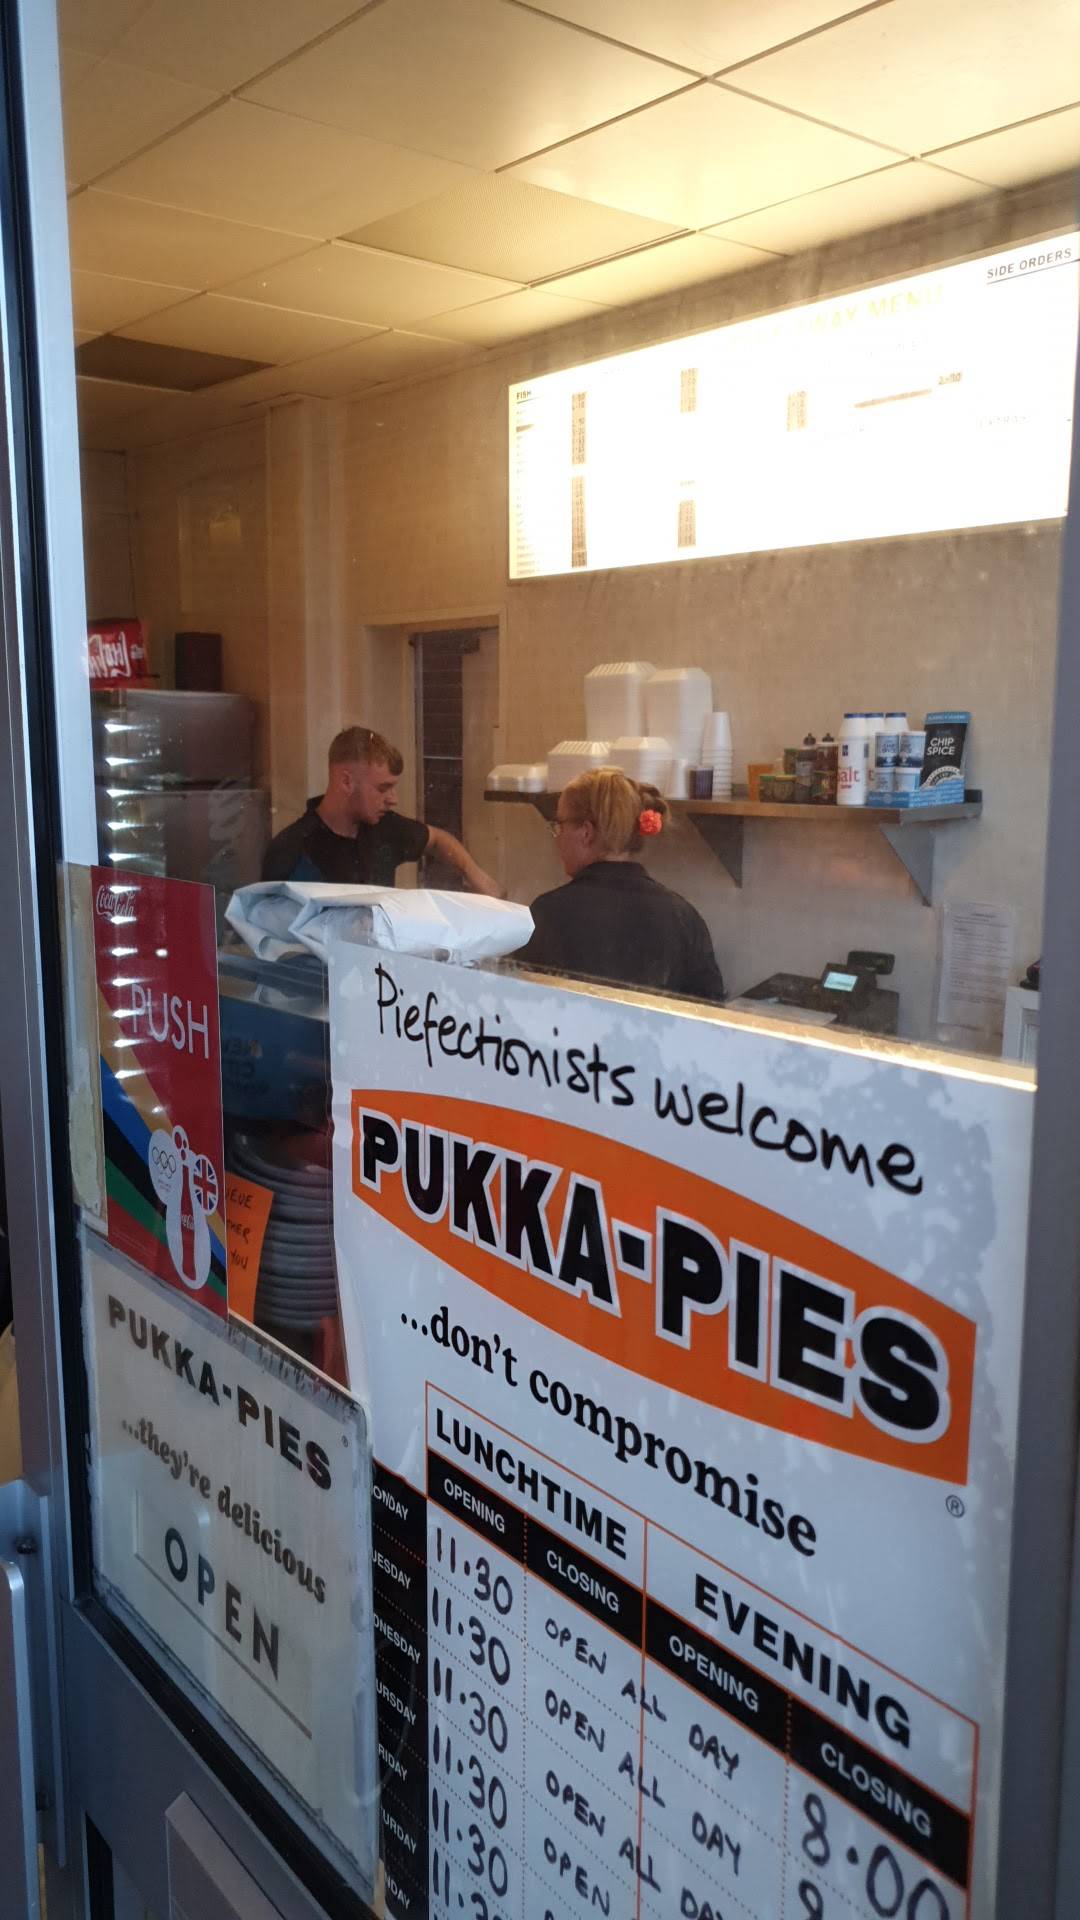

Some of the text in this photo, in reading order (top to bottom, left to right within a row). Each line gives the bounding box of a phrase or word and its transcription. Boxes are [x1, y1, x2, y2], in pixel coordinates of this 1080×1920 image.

[986, 247, 1072, 279] SIDE ORDERS
[516, 390, 533, 400] FISH
[926, 746, 956, 756] SPICE
[930, 737, 955, 747] CHIP
[131, 983, 209, 1060] PUSH
[374, 962, 636, 1106] Piefectionists
[654, 1077, 923, 1195] welcome
[229, 1249, 249, 1270] YOU
[358, 1107, 950, 1440] PUKKA-PIES
[108, 1293, 331, 1490] PUKKA-PIES
[373, 1484, 409, 1521] ONDAY
[436, 1408, 627, 1561] LUNCHTIME
[529, 1367, 818, 1557] compromise
[164, 1527, 280, 1682] OPEN
[217, 1484, 326, 1604] delicious
[443, 1477, 620, 1615] OPENING CLOSING
[436, 1527, 740, 1781] 11.30 OPEN ALL DAY
[695, 1573, 911, 1749] EVENING
[378, 1743, 408, 1781] RIDAY
[432, 1586, 741, 1876] 11.30 OPEN ALL DAY
[433, 1657, 508, 1754] 11.30
[545, 1769, 606, 1838] OPEN
[433, 1722, 508, 1829] 11.30
[668, 1635, 931, 1839] OPENING CLOSING
[432, 1787, 611, 1917] 11.30 OPEN
